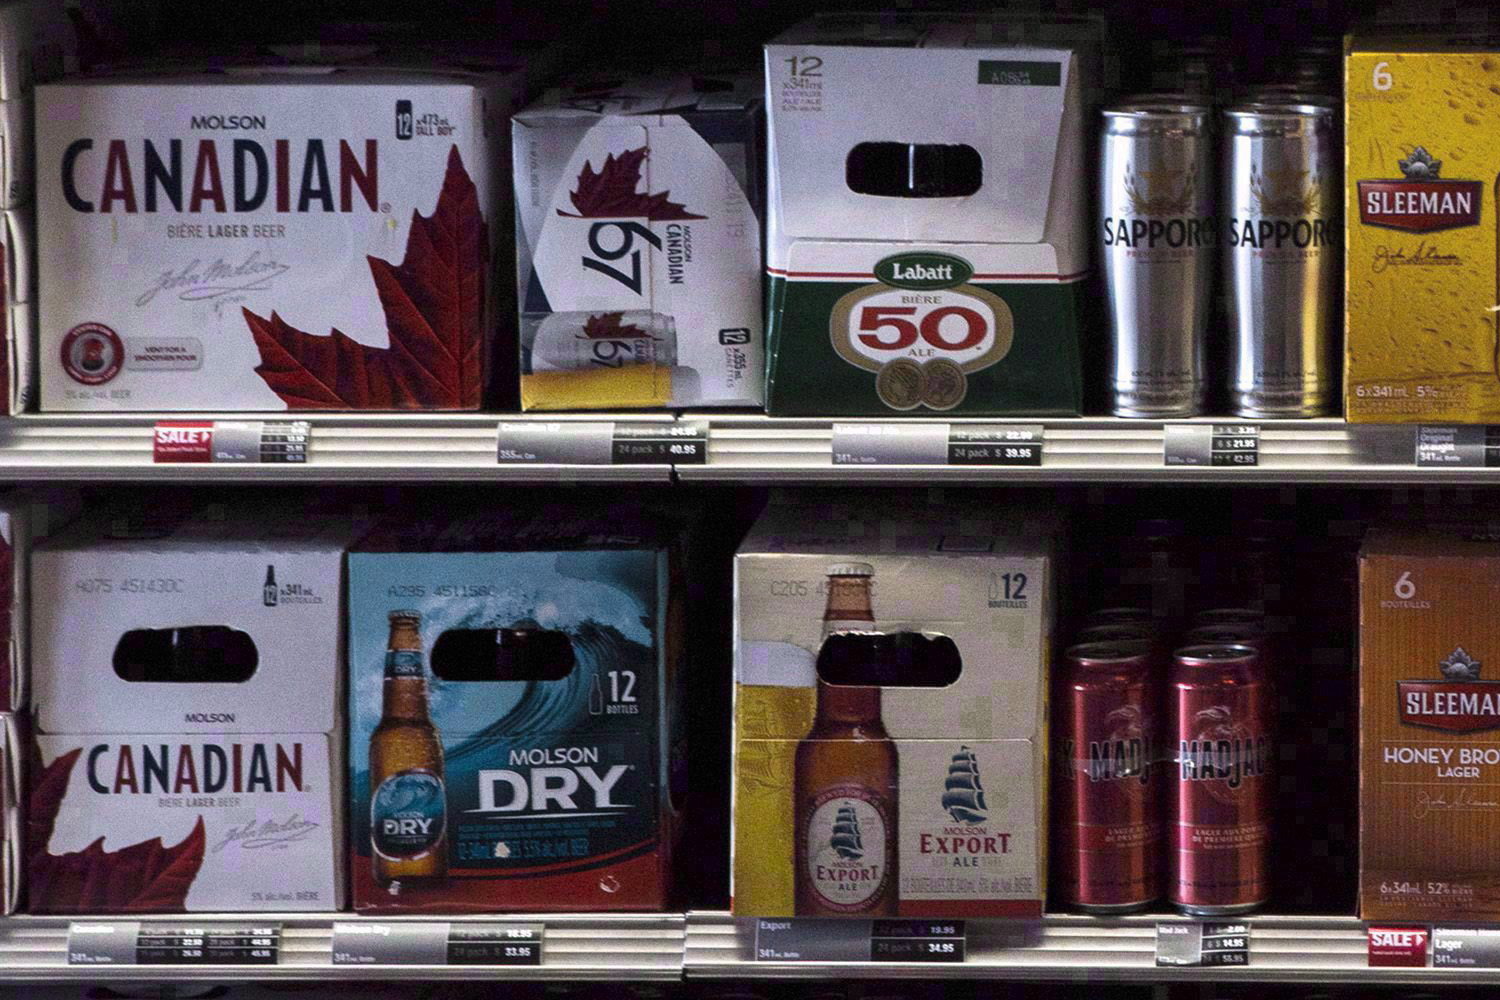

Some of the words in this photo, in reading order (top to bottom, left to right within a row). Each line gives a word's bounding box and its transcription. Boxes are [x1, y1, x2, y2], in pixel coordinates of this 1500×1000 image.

[1372, 63, 1392, 90] 6
[191, 115, 266, 130] MOLSON
[61, 139, 381, 214] CANADIAN
[1368, 192, 1471, 216] SLEEMAN
[167, 223, 203, 239] BIÈRE
[207, 224, 250, 239] LAGER
[253, 224, 285, 239] BEER
[582, 221, 662, 296] 67
[666, 224, 684, 284] CANADIAN
[893, 263, 952, 280] Labatt
[901, 294, 942, 304] BIÈRE
[858, 306, 988, 351] 50
[156, 431, 197, 443] SALE
[1005, 448, 1031, 458] 39.95
[1001, 573, 1026, 600] 12
[1395, 572, 1415, 600] 6
[609, 671, 636, 702] 12
[607, 705, 638, 714] BOTTLES
[185, 714, 235, 723] MOLSON
[509, 748, 598, 766] MOLSON
[1384, 748, 1453, 766] HONEY
[87, 744, 303, 794] CANADIAN
[1438, 765, 1480, 778] LAGER
[478, 765, 629, 810] DRY
[384, 819, 432, 835] DRY
[944, 826, 986, 835] MOLSON
[920, 833, 1012, 855] EXPORT
[953, 856, 978, 868] ALE
[816, 865, 878, 882] EXPORT
[760, 920, 791, 932] Export
[928, 944, 954, 953] 34.95
[1372, 935, 1412, 947] SALE
[1435, 940, 1463, 950] Lager
